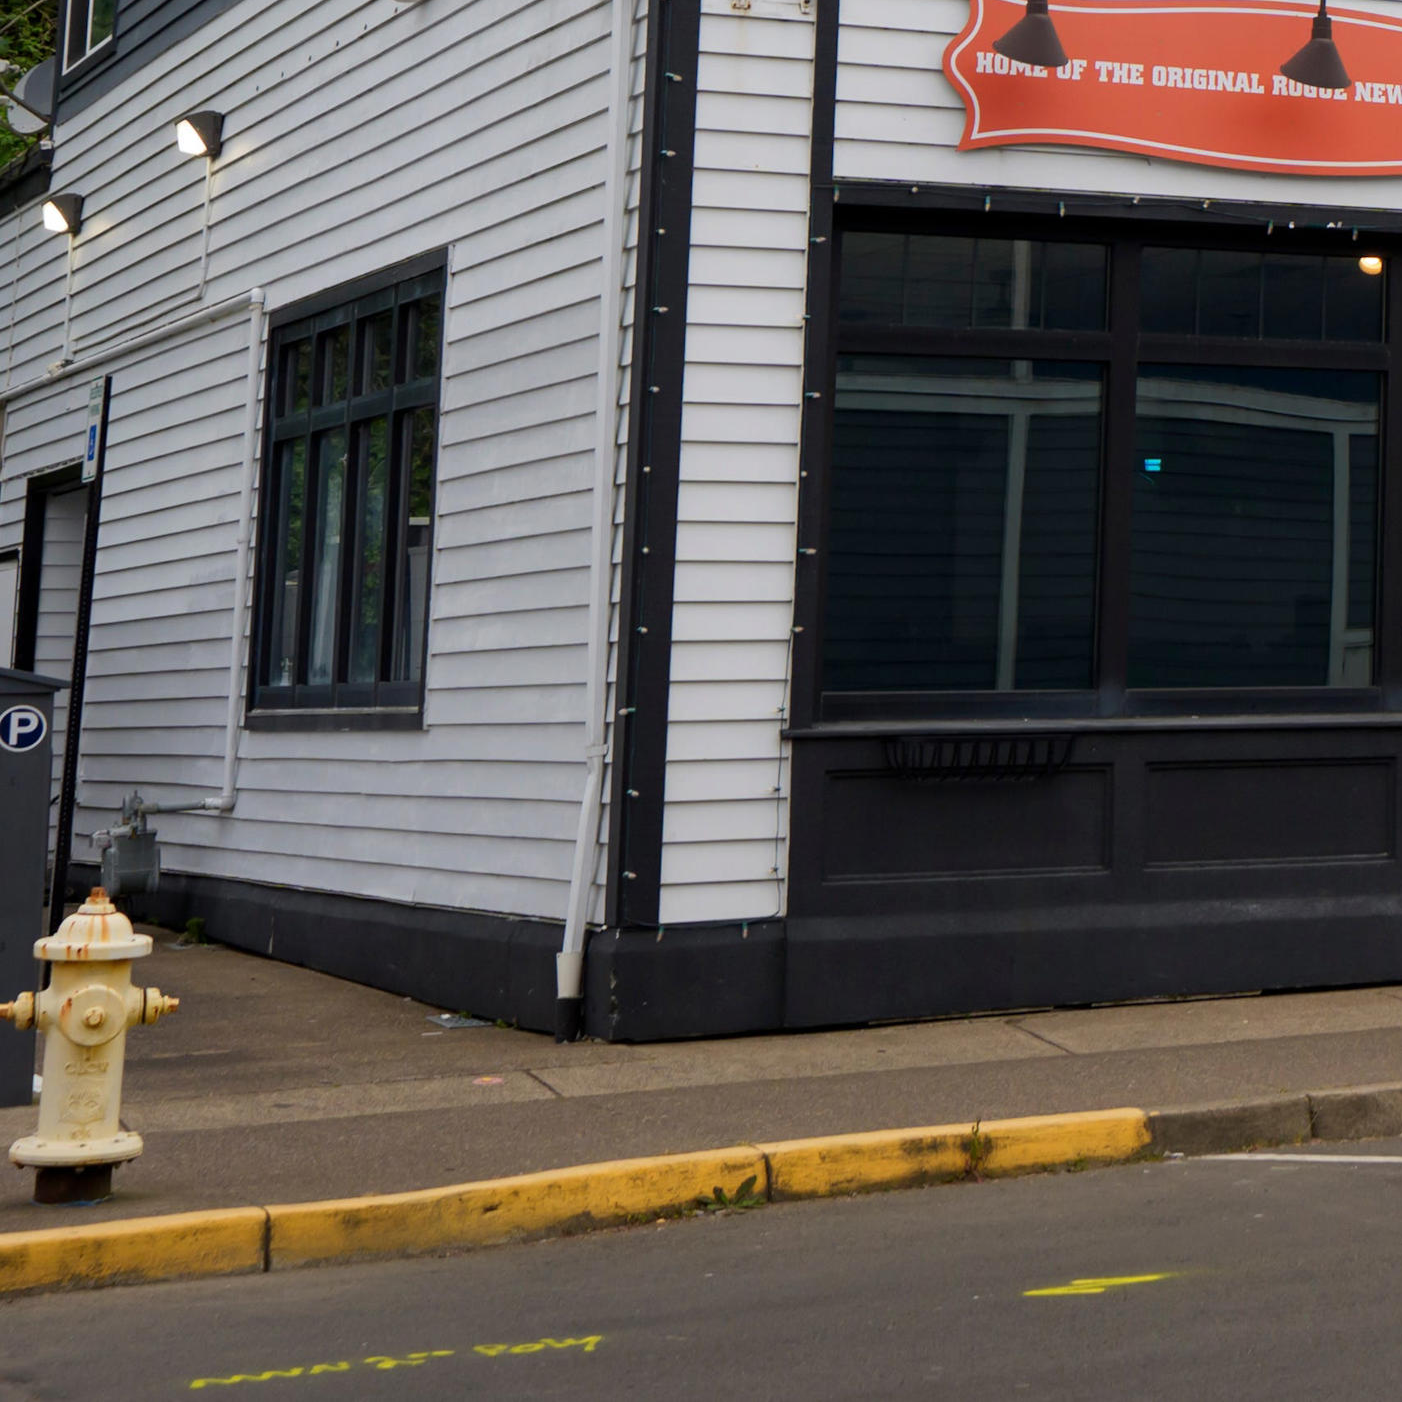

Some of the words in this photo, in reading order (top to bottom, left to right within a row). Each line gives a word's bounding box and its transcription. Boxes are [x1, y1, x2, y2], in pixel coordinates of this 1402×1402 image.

[976, 51, 1048, 78] HOME
[1056, 59, 1087, 80] OF
[1095, 61, 1144, 86] THE
[1152, 65, 1265, 96] ORIGINAL
[9, 711, 39, 746] P
